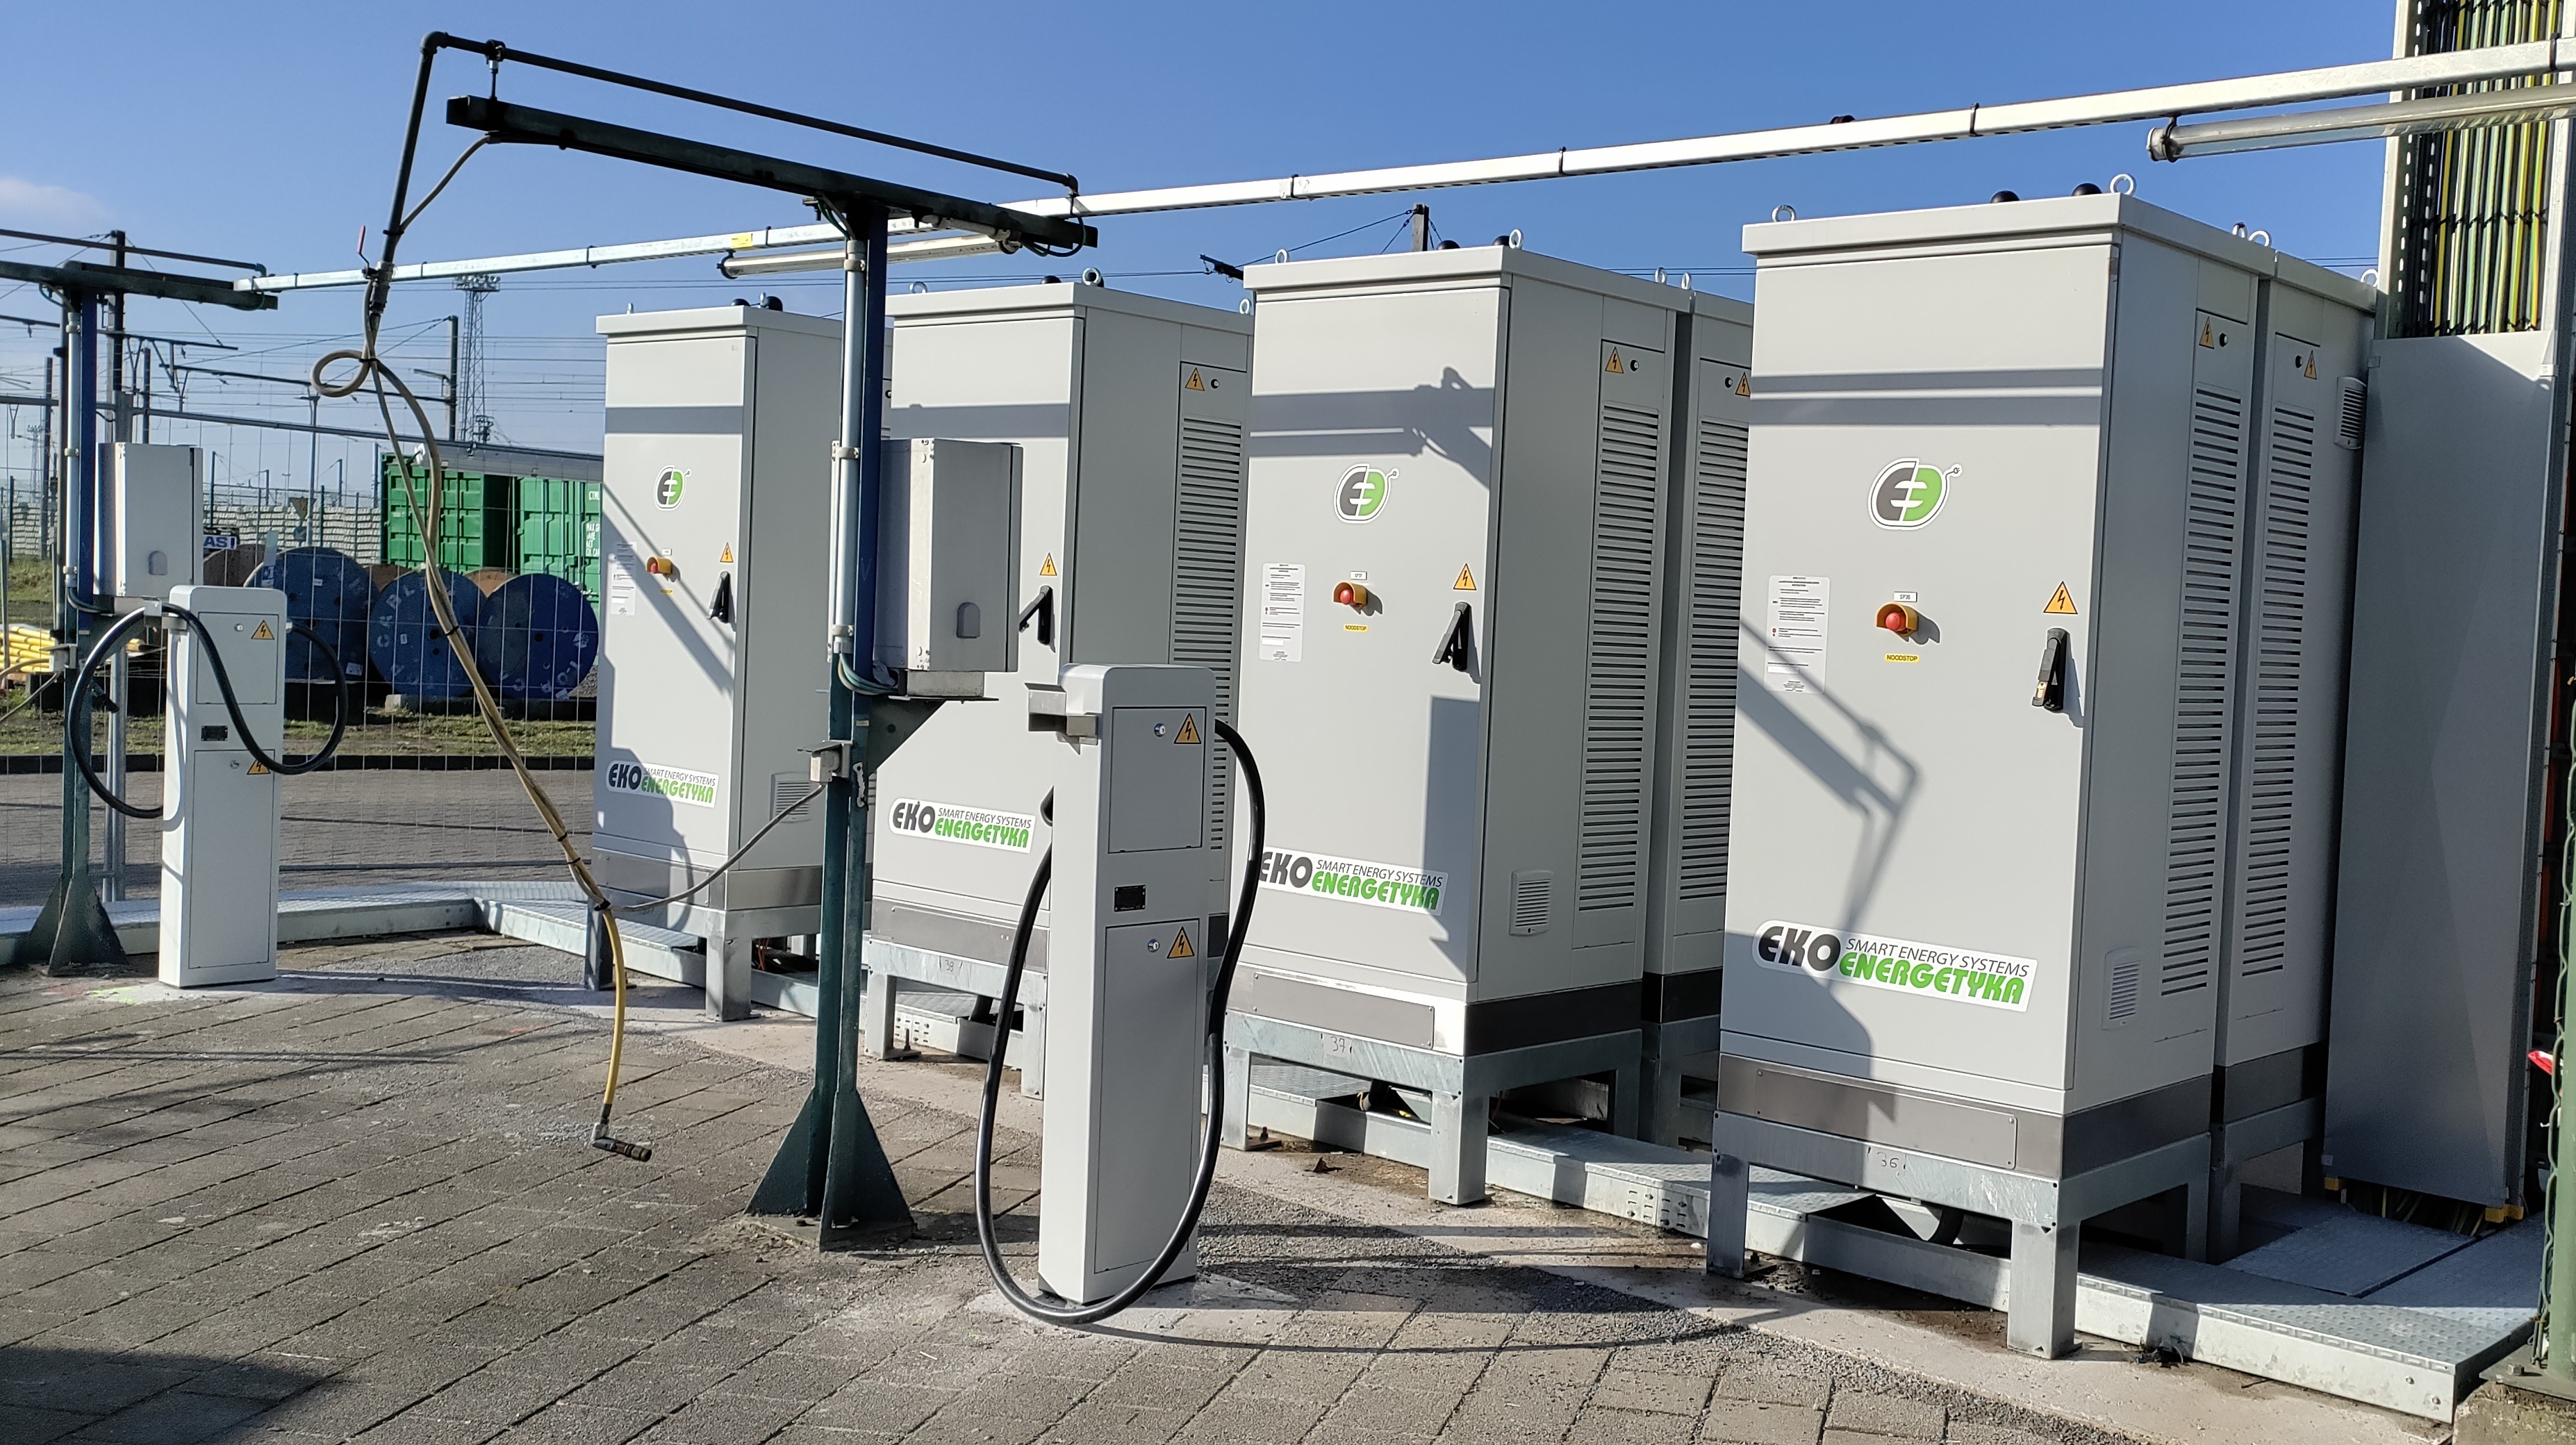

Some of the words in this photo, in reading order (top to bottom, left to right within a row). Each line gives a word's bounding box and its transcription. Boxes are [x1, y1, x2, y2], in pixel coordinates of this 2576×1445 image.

[609, 763, 642, 790] EKO
[641, 775, 714, 803] ENERGETYKA
[643, 767, 664, 777] SMART
[664, 770, 689, 782] ENERGY
[689, 774, 716, 786] SYSTEMS
[893, 802, 935, 833] EKO
[938, 807, 965, 818] SMART
[965, 811, 996, 823] ENERGY
[996, 815, 1032, 829] SYSTEMS
[934, 817, 1029, 848] ENERGETYKA
[1258, 851, 1313, 889] EKO
[1316, 859, 1353, 874] SMART
[1353, 865, 1396, 880] ENERGY
[1394, 870, 1443, 887] SYSTEMS
[1312, 870, 1440, 910] ENERGETYKA
[1758, 925, 1841, 972] EKO
[1845, 938, 1898, 957] SMART
[1898, 946, 1960, 966] ENERGY
[1959, 955, 2030, 977] SYSTEMS
[945, 959, 954, 972] 38
[1839, 951, 2024, 1005] ENERGETYKA
[1330, 1036, 1346, 1053] 37
[1877, 1152, 1899, 1169] 36
